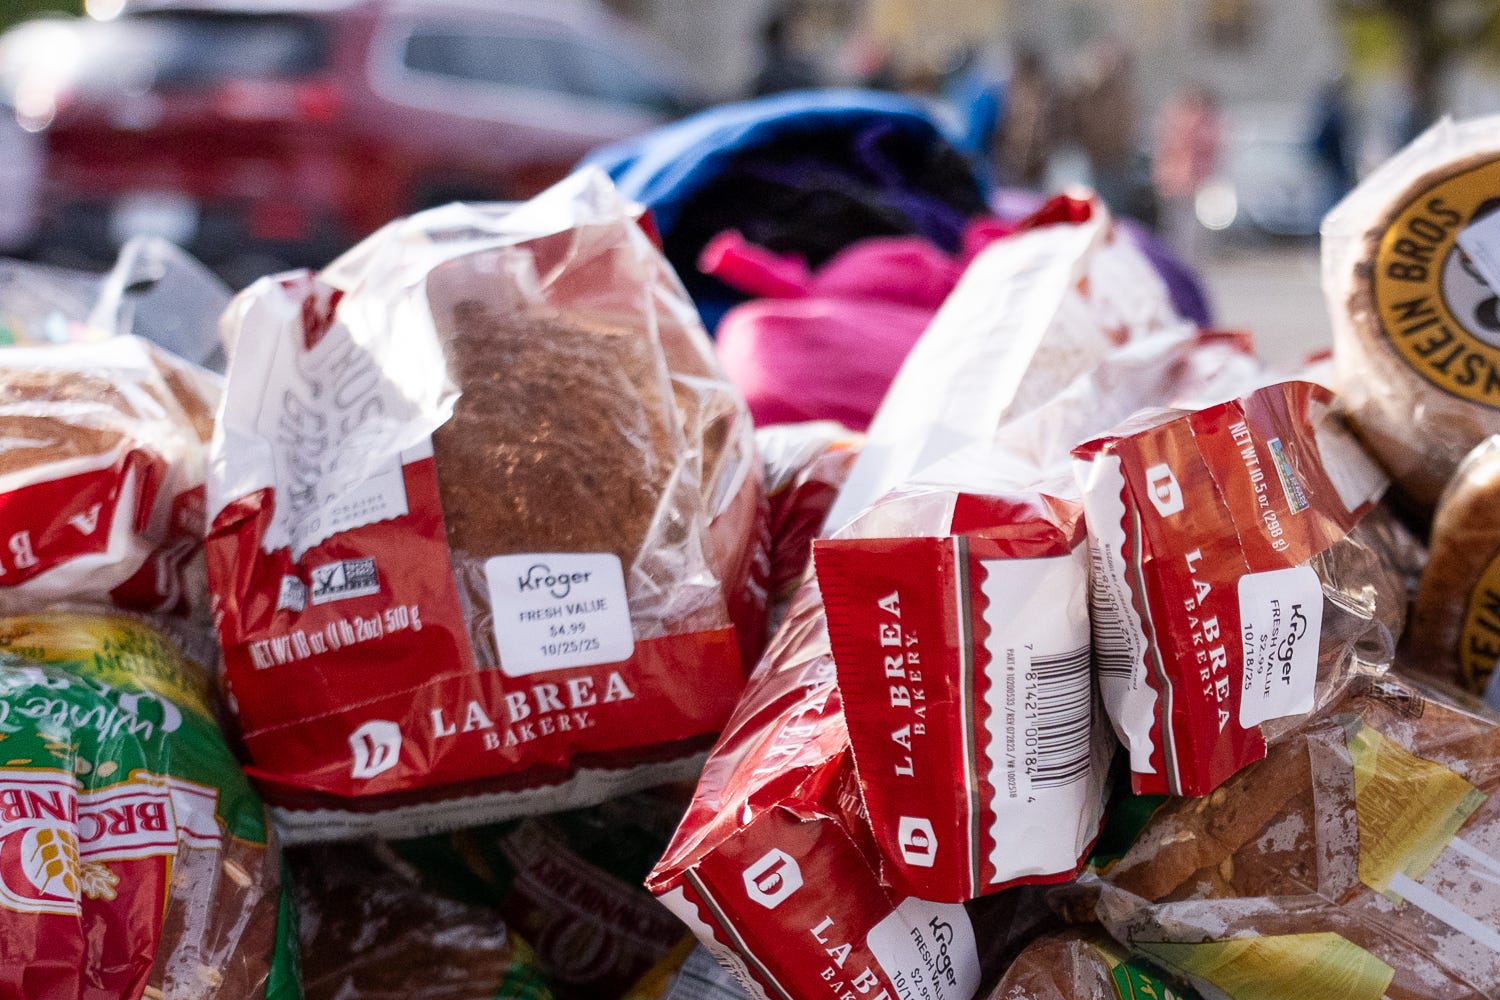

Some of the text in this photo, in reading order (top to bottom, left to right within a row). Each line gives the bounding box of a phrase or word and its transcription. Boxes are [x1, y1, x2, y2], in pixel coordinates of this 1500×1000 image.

[1386, 198, 1462, 283] BROS
[1227, 421, 1253, 446] NET
[1238, 445, 1260, 468] WT
[1247, 466, 1267, 494] 10.5
[1257, 493, 1270, 509] oz
[1260, 508, 1284, 539] (298
[1269, 536, 1291, 554] g)
[518, 564, 592, 599] Kroger
[384, 605, 409, 633] 510
[410, 604, 423, 632] g
[519, 599, 608, 623] FRESH VALUE
[549, 622, 586, 638] $4.99
[540, 638, 600, 657] 10/25/25
[1184, 547, 1231, 735] LA BREA
[1184, 597, 1214, 699] BAKERY
[1244, 623, 1255, 690] 10/18/25
[1257, 634, 1269, 675] $2.99
[1263, 599, 1281, 700] FRESH VALUE
[1277, 603, 1307, 685] Kroger
[430, 671, 635, 739] LA BREA
[878, 589, 914, 778] LA BREA
[905, 632, 928, 735] BAKERY
[1023, 642, 1037, 803] 7 81421 00184 4
[810, 915, 854, 969] LA
[910, 927, 935, 972] FRESH
[928, 916, 958, 987] Kroger
